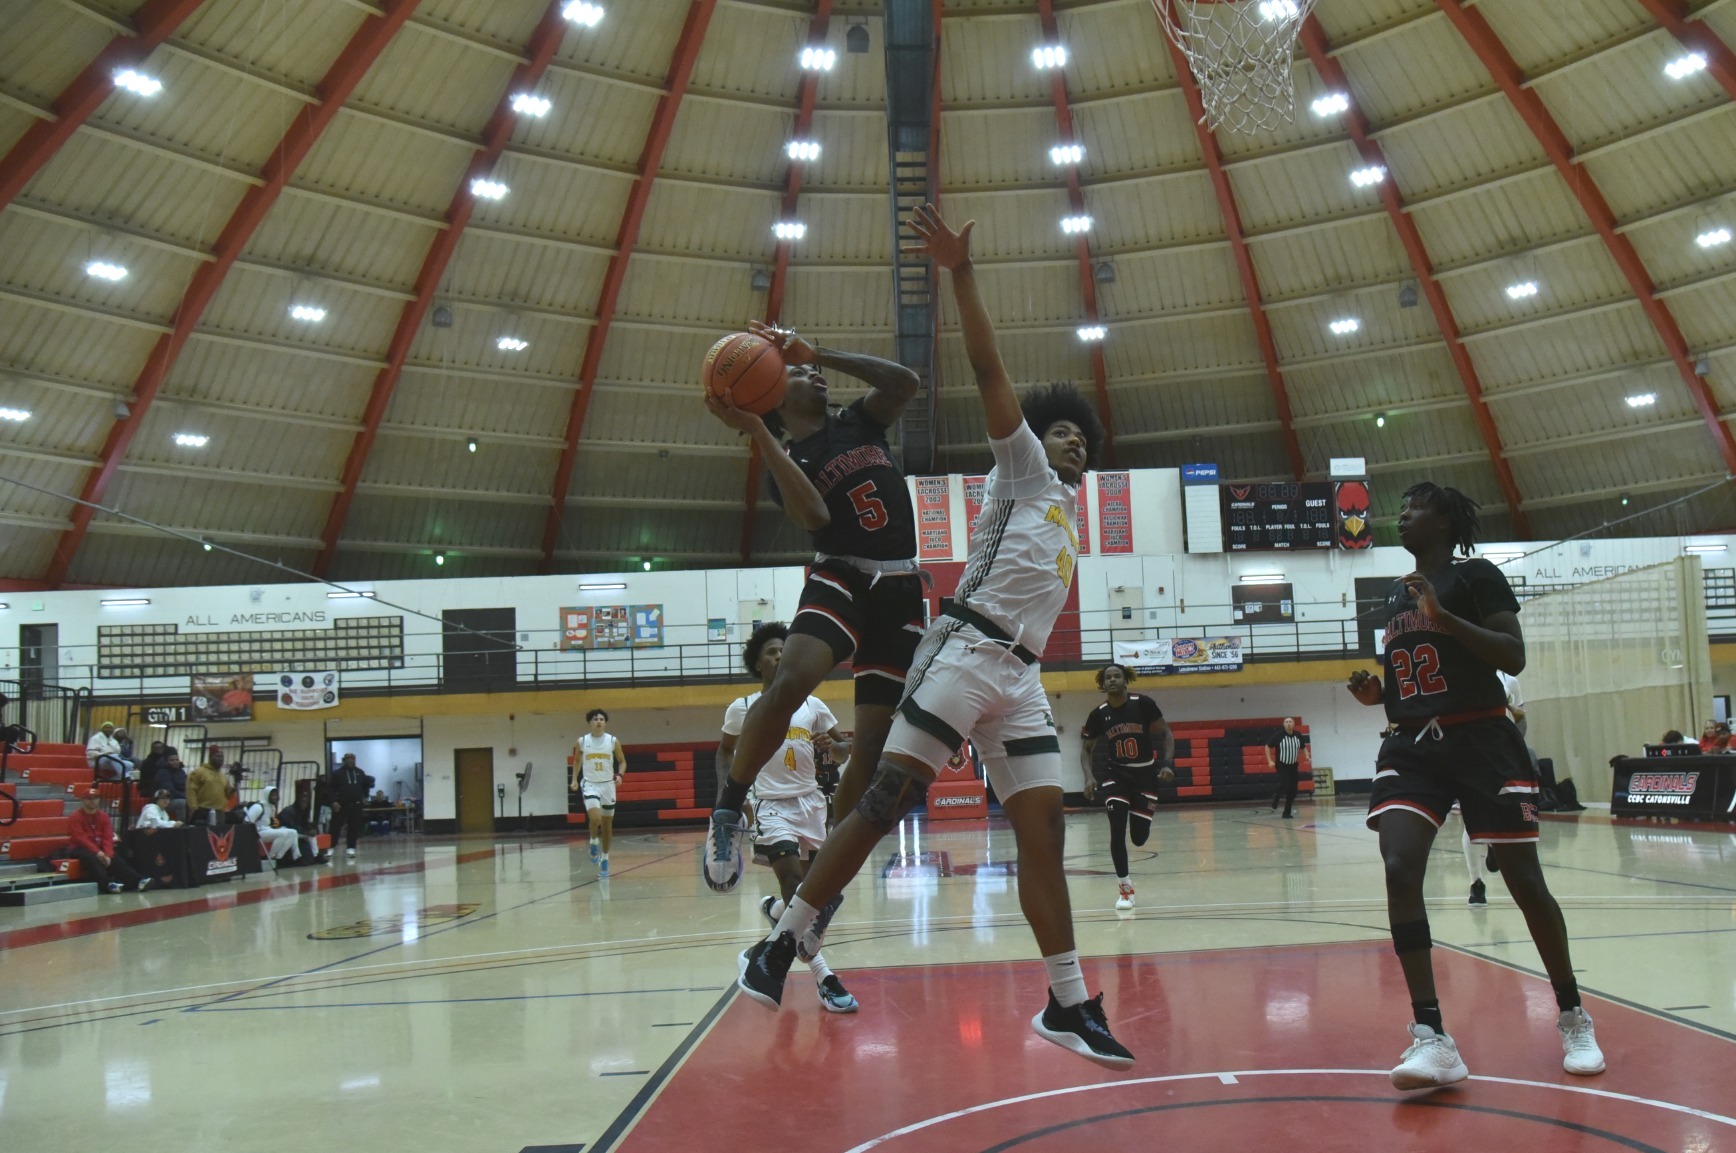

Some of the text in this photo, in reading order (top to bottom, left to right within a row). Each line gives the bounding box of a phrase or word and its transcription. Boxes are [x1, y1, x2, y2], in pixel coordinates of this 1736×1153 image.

[814, 445, 892, 496] ALTIMORE
[847, 480, 888, 532] 5
[1535, 568, 1562, 578] ALL
[186, 611, 326, 626] ALL AMERICANS
[1391, 643, 1448, 700] 22
[148, 708, 176, 722] GYM
[179, 707, 186, 720] 1
[1116, 737, 1138, 759] 10
[595, 762, 603, 771] 11
[784, 748, 797, 771] 4
[1630, 773, 1699, 793] CARDINALS
[934, 796, 983, 807] CARDINALS
[1628, 794, 1691, 804] CCBC CATONSVILLE
